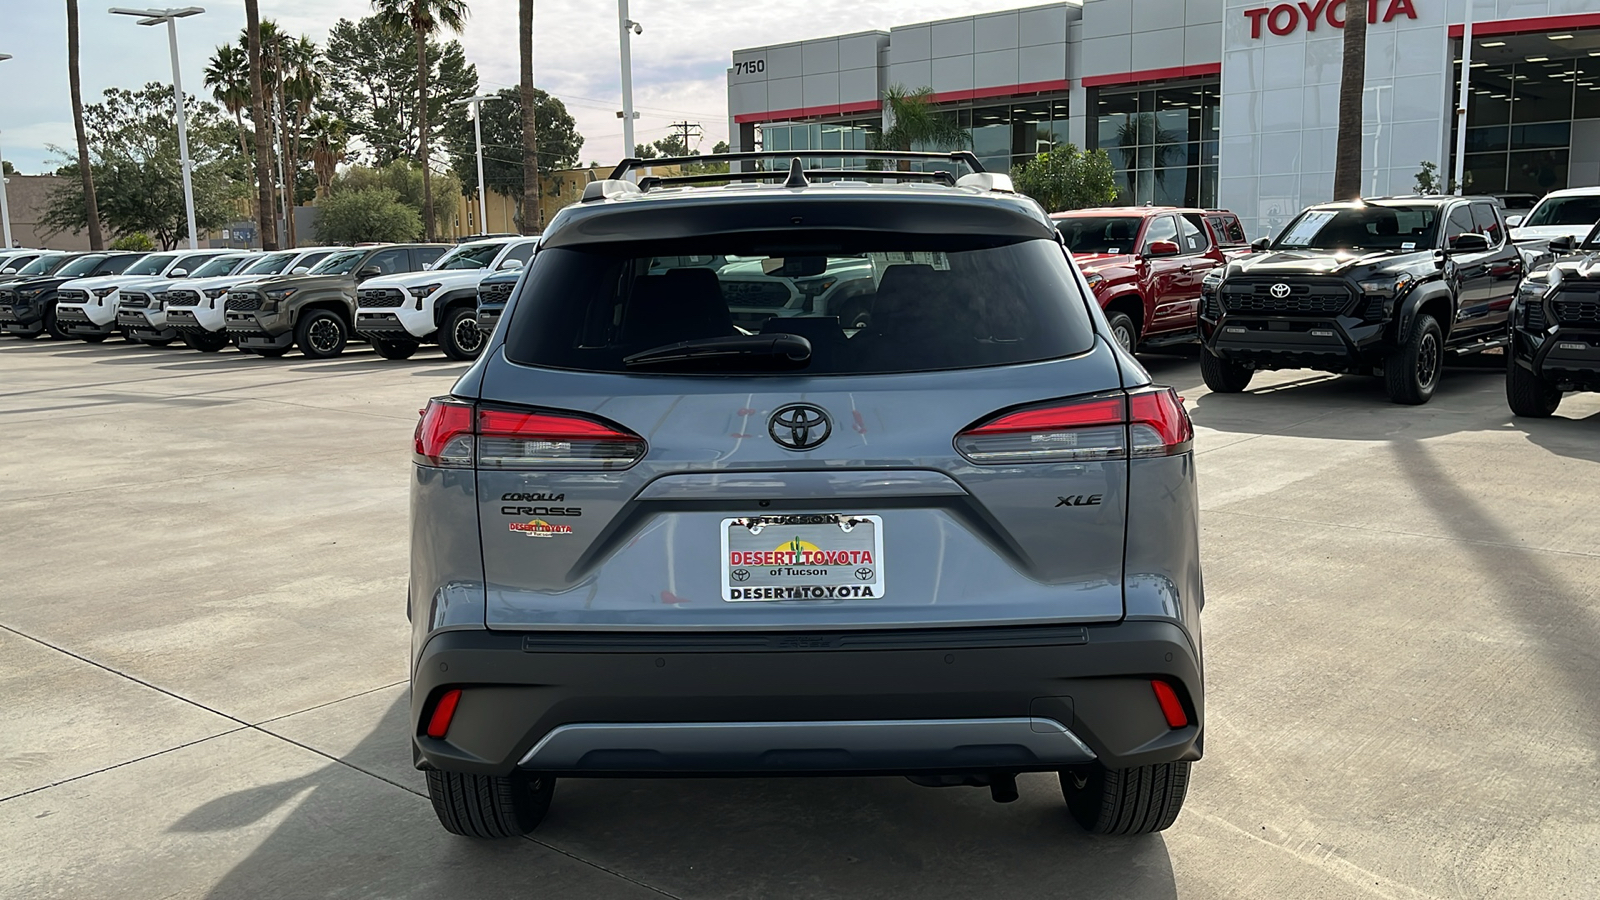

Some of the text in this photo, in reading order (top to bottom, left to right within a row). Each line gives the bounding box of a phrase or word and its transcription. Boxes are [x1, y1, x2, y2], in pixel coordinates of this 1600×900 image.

[735, 60, 765, 75] 7150
[501, 492, 565, 502] COROLLA
[1055, 494, 1103, 508] XLE
[501, 506, 582, 516] CROSS
[763, 515, 839, 524] TUCSON
[509, 523, 572, 533] DESERT TOYOTA
[731, 551, 873, 566] DESERT TOYOTA
[770, 567, 828, 577] of Tucson
[730, 586, 874, 600] DESERT TOYOTA
